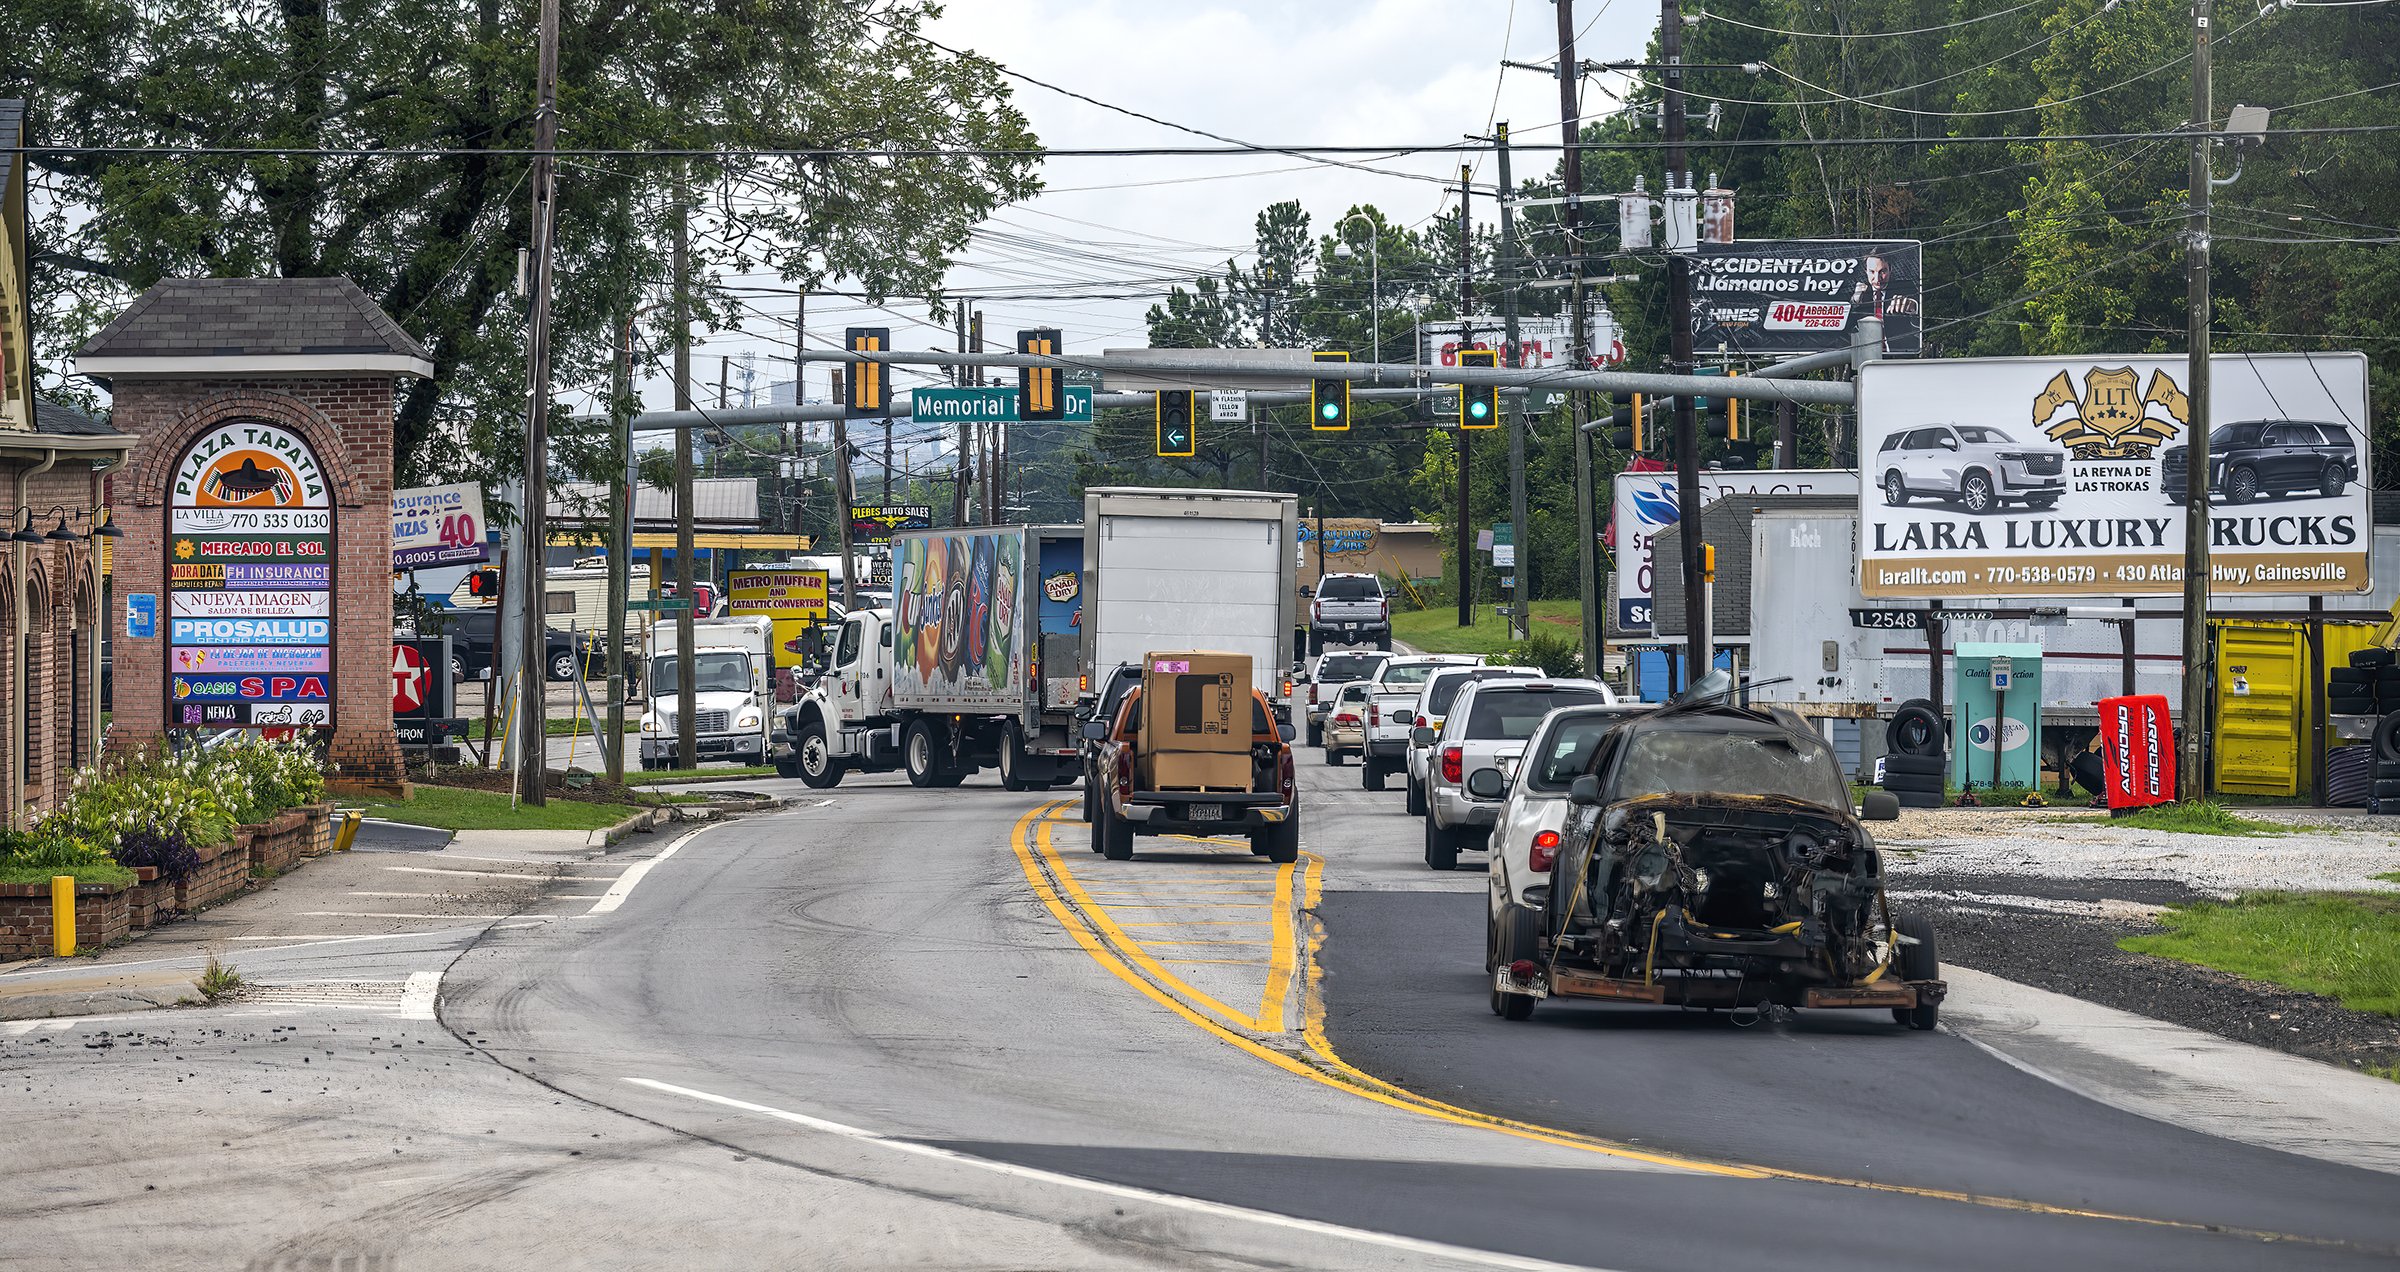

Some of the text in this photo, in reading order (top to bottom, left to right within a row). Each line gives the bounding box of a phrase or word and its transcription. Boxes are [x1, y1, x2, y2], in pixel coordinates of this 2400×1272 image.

[1697, 275, 1844, 295] Llámanos hoy
[1708, 304, 1845, 323] HINES 404 ABOGADO
[918, 395, 1005, 416] Memorial
[1065, 395, 1087, 415] Dr
[2094, 388, 2130, 406] LLT
[176, 428, 323, 499] PLAZA TAPATIA
[2073, 466, 2152, 478] LA REYNA DE
[2075, 481, 2150, 492] LAS TROKAS
[175, 510, 329, 529] LA VILLA 770 535 0130
[852, 506, 929, 519] PLEBES AUTO SALES
[393, 520, 429, 538] NZAS
[1873, 515, 2357, 552] LARA LUXURY RUCKS
[201, 541, 326, 556] MERCADO EL SOL
[732, 574, 822, 591] METRO MUFFLER
[1879, 562, 2347, 586] larallt.com 770-538-0579 430 Atla Hwy, Gainesville
[769, 587, 788, 597] AND
[1044, 578, 1079, 595] CANADA
[1055, 586, 1073, 598] DRY
[190, 593, 312, 606] NUEVA IMAGEN
[731, 598, 825, 609] CATALYTIC CONVERTERS
[207, 607, 295, 615] SALON DE BELLEZA
[1936, 611, 1988, 620] LAMAR
[1858, 612, 1917, 628] L2548
[174, 621, 328, 638] PROSALUD
[192, 677, 327, 698] OASIS SPA
[2118, 704, 2132, 797] ARROYO
[2146, 704, 2160, 797] ARROYO
